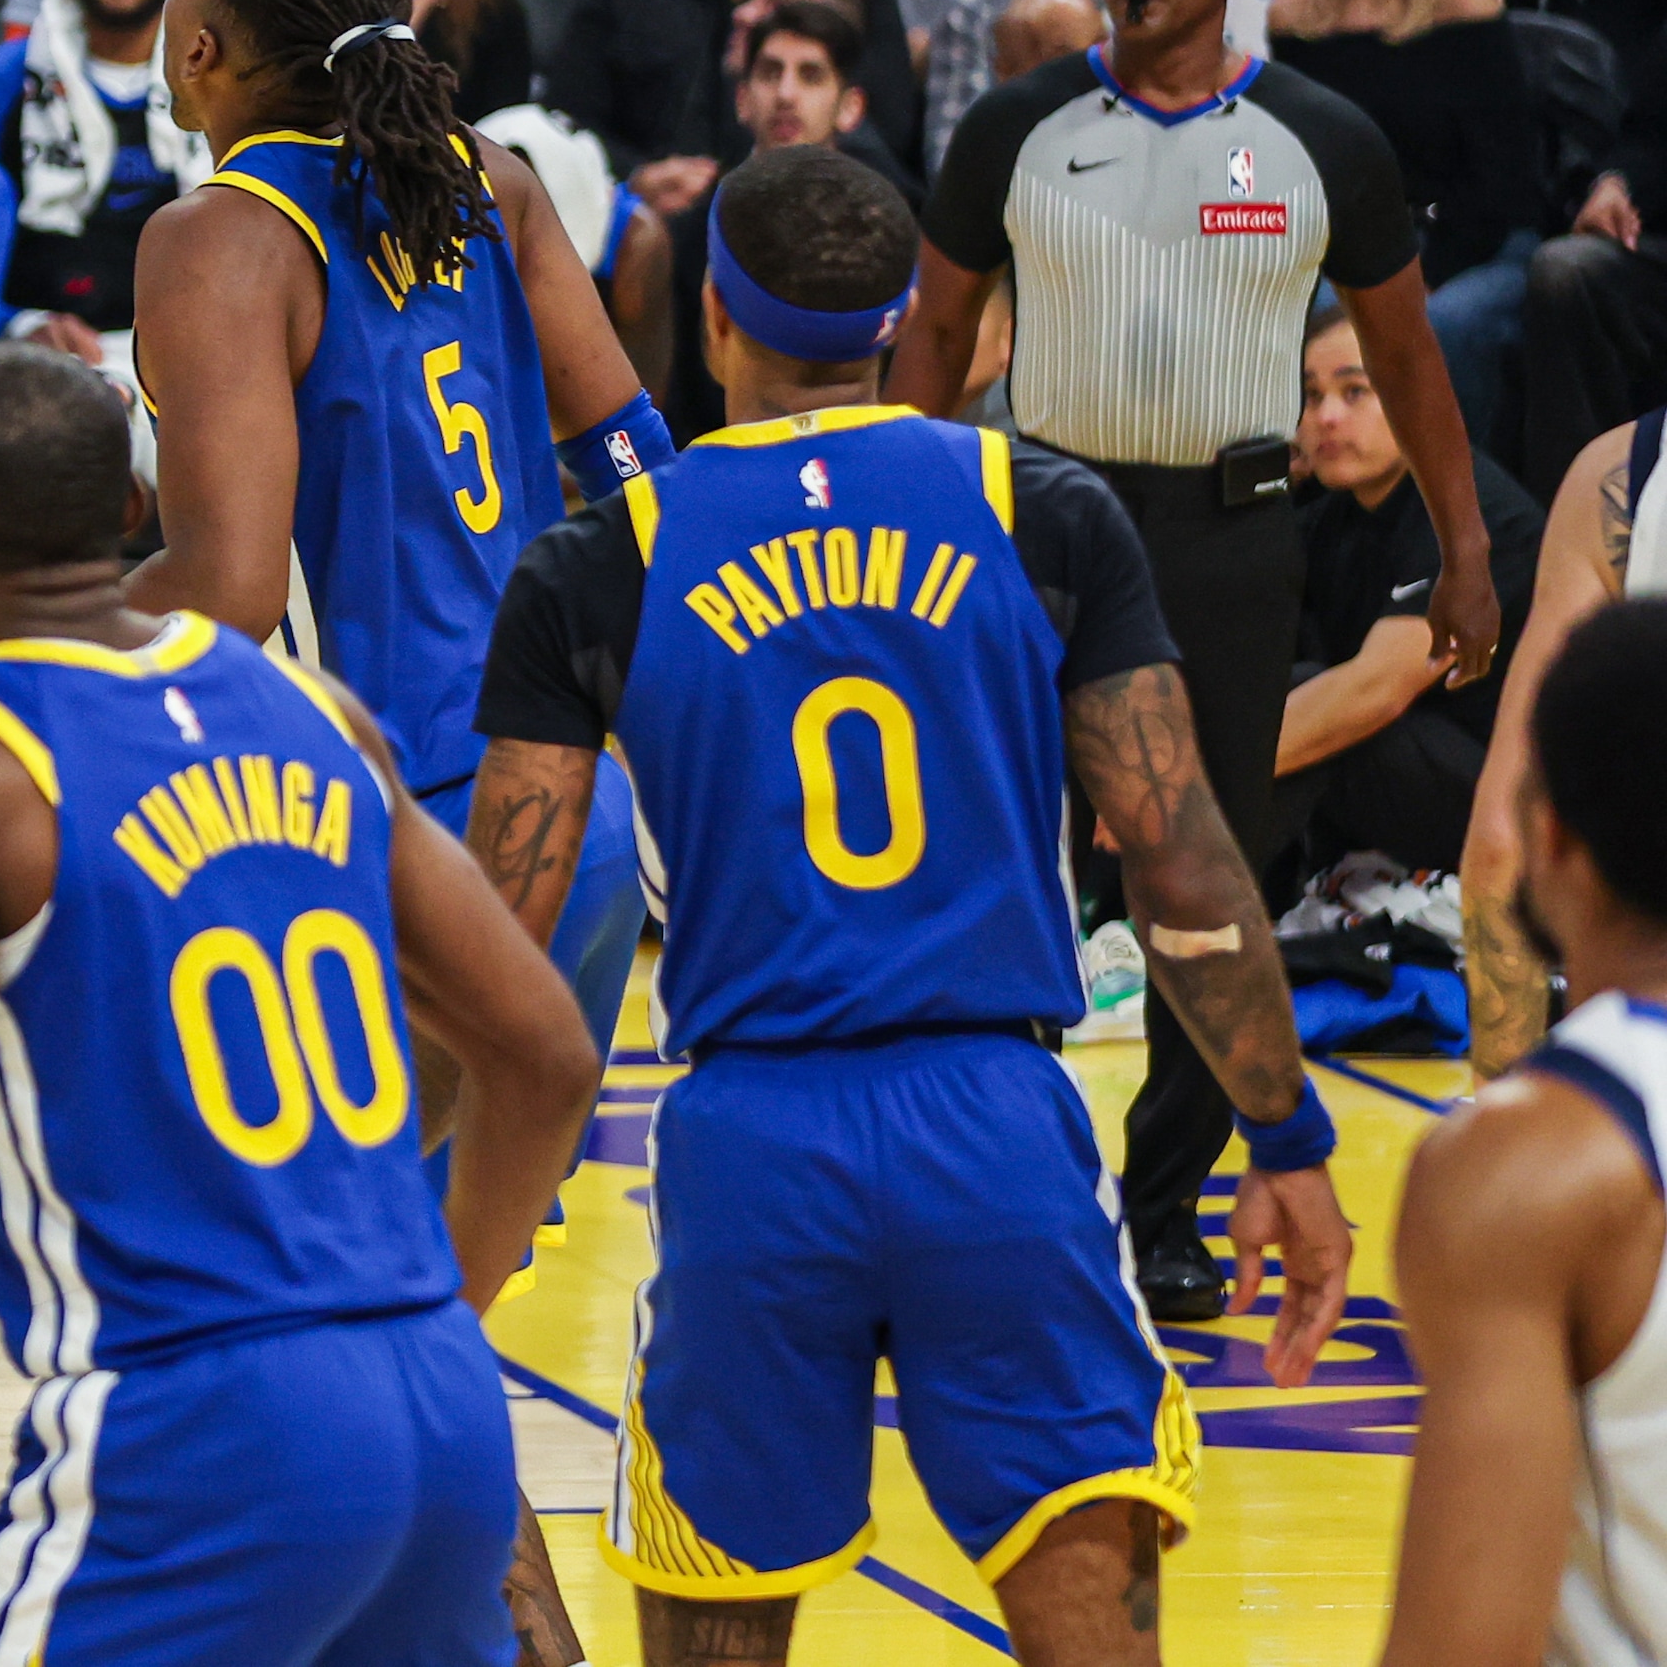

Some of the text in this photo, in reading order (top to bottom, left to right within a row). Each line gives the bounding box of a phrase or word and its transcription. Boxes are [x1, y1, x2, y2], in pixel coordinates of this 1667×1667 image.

[1202, 205, 1286, 231] Emirates
[423, 341, 503, 535] 5
[684, 526, 977, 655] PAYTON II
[112, 754, 352, 900] KUMINGA
[792, 676, 926, 891] 0
[169, 908, 410, 1168] 00
